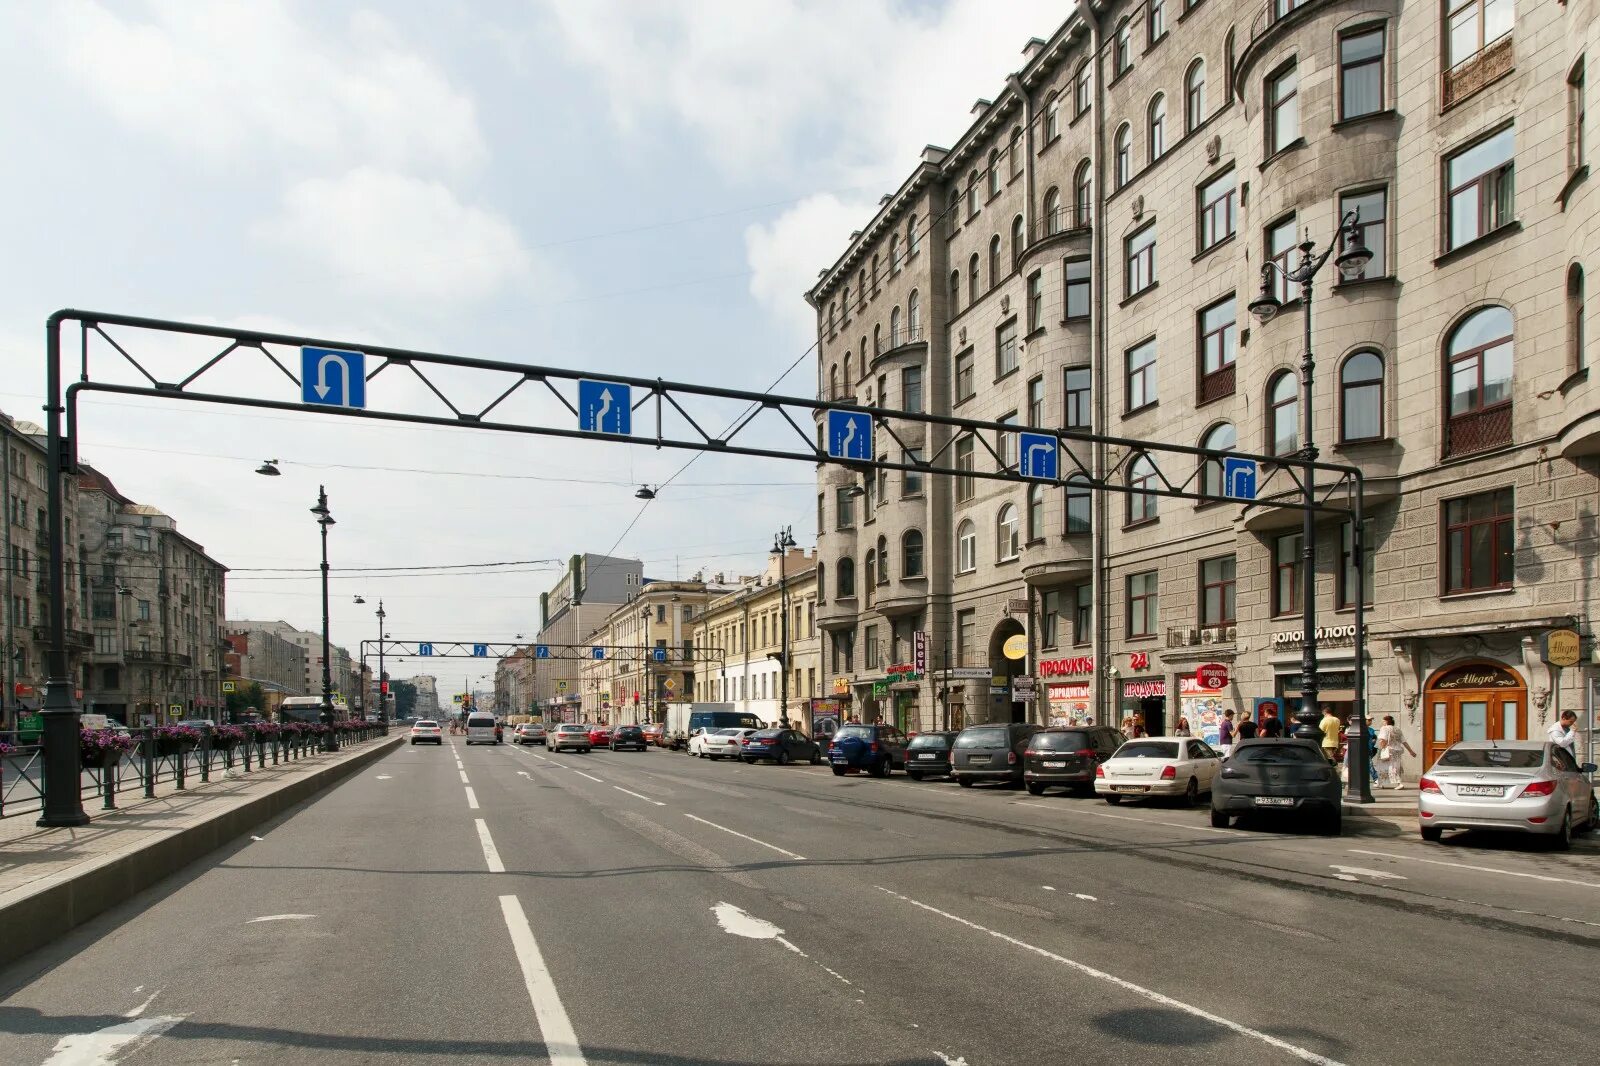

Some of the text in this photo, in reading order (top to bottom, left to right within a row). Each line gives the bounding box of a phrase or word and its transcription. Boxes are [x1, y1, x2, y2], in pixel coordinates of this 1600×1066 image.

[1271, 624, 1365, 643] ЗОЛОТЙ ЛОТО
[1548, 641, 1578, 655] Allegro
[1040, 656, 1094, 677] ПРОДУКТЫ
[1130, 652, 1147, 670] 24
[1202, 669, 1228, 677] ПРОДУКТЫ
[1456, 673, 1497, 685] Allegro
[1210, 678, 1219, 686] 24
